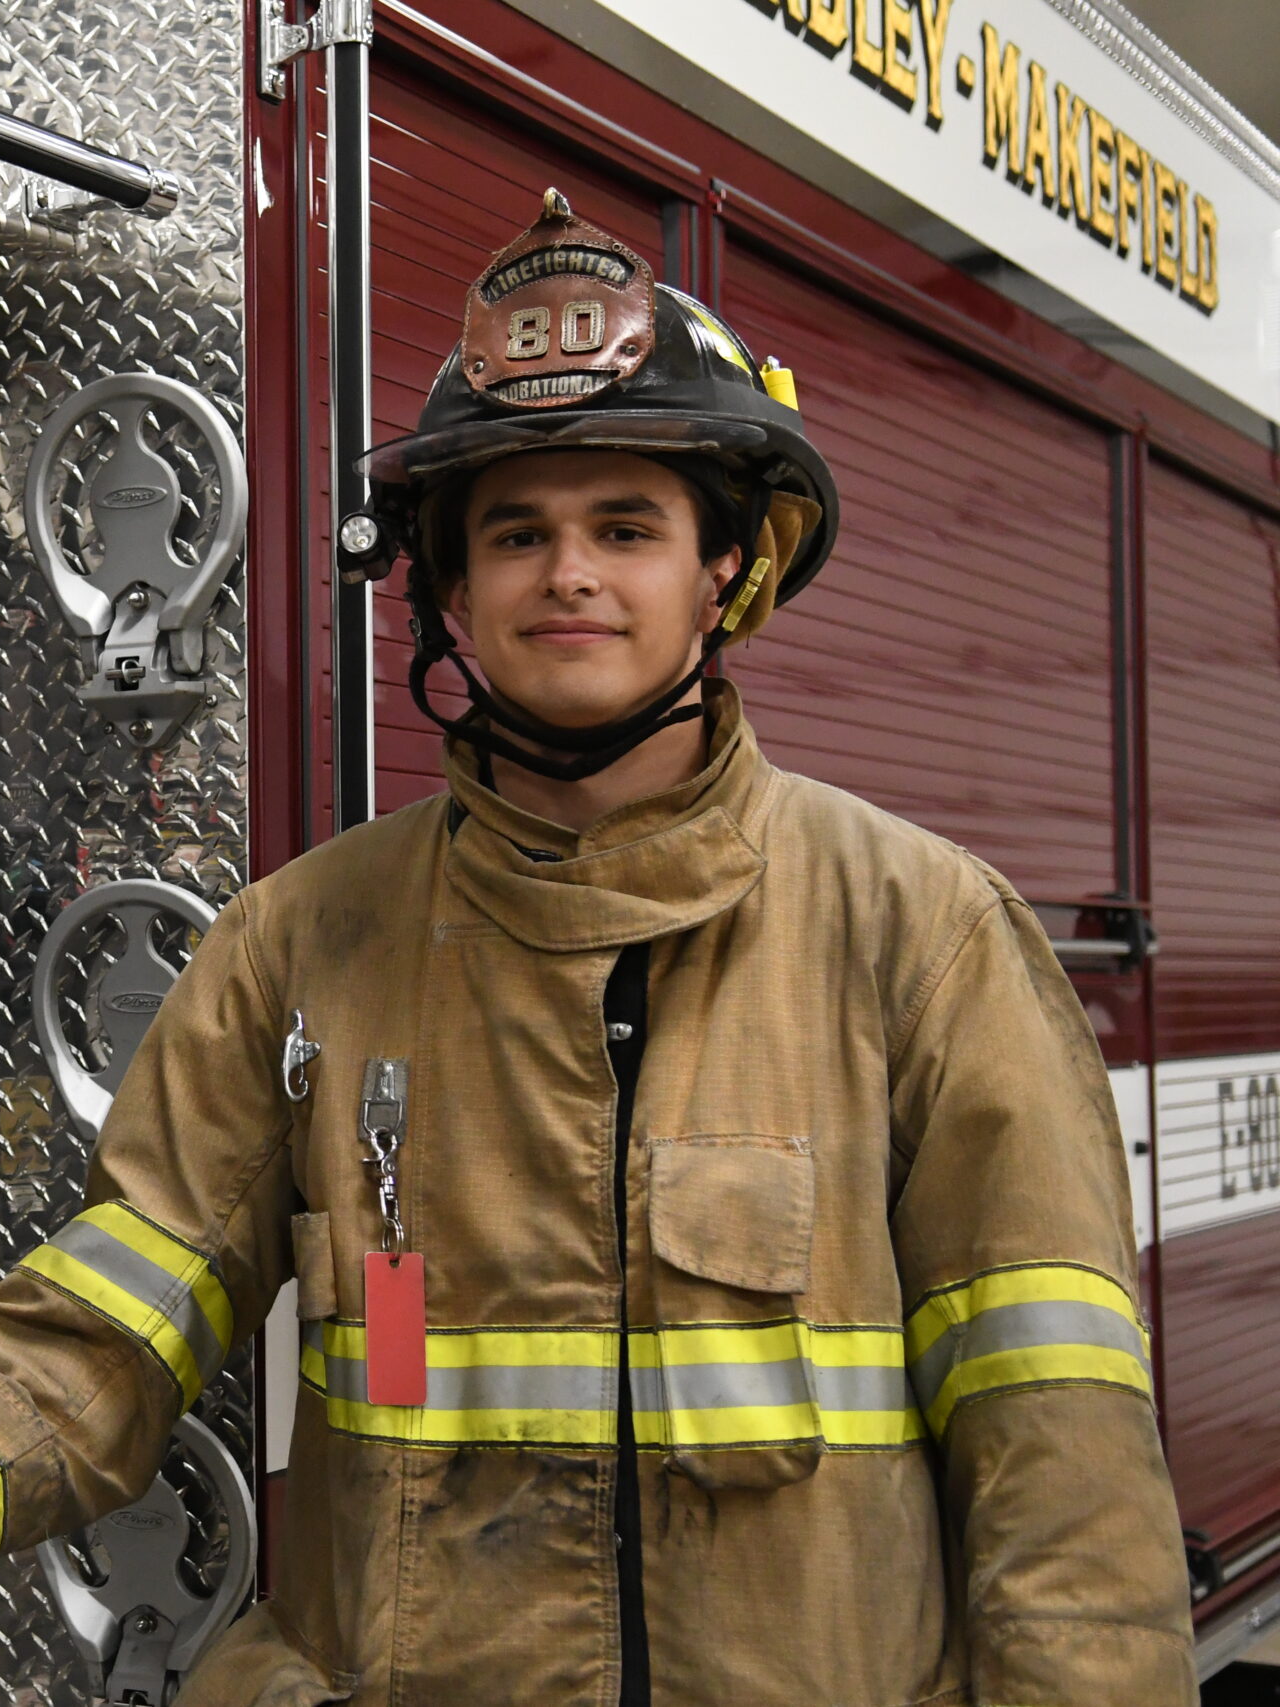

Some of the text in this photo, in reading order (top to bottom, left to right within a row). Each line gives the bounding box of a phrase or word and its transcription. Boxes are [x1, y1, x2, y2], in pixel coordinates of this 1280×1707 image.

[982, 22, 1220, 318] MAKEFIELD
[488, 250, 627, 300] FIREFIGHTER
[505, 301, 606, 360] 80
